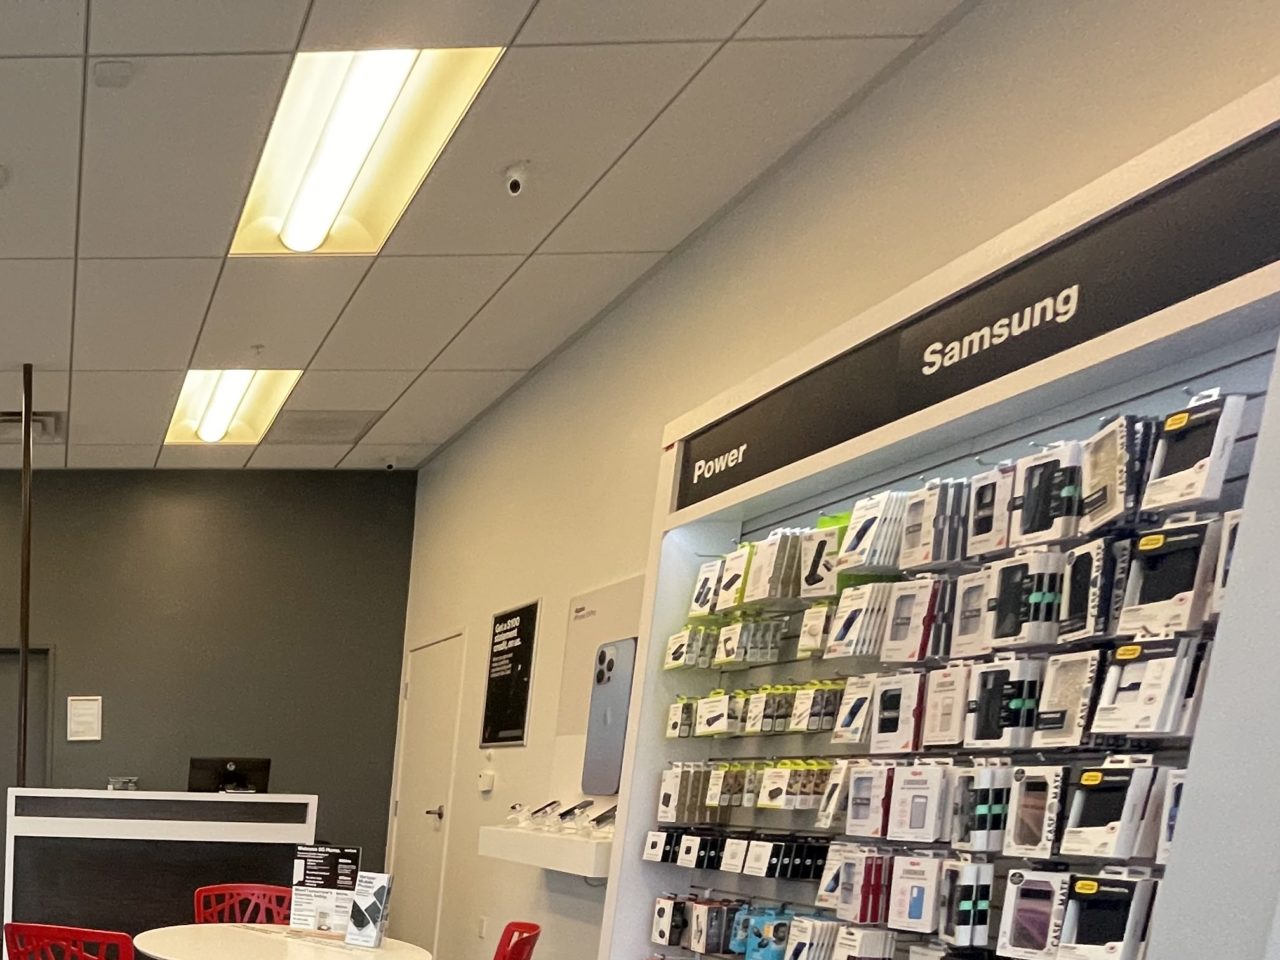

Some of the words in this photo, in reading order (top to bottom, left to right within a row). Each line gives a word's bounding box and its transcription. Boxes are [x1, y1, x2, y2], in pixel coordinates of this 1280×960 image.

[921, 284, 1079, 375] Samsung
[692, 443, 748, 484] Power
[1051, 772, 1063, 800] MATE
[1050, 921, 1062, 947] CASE
[1058, 879, 1070, 907] MATE
